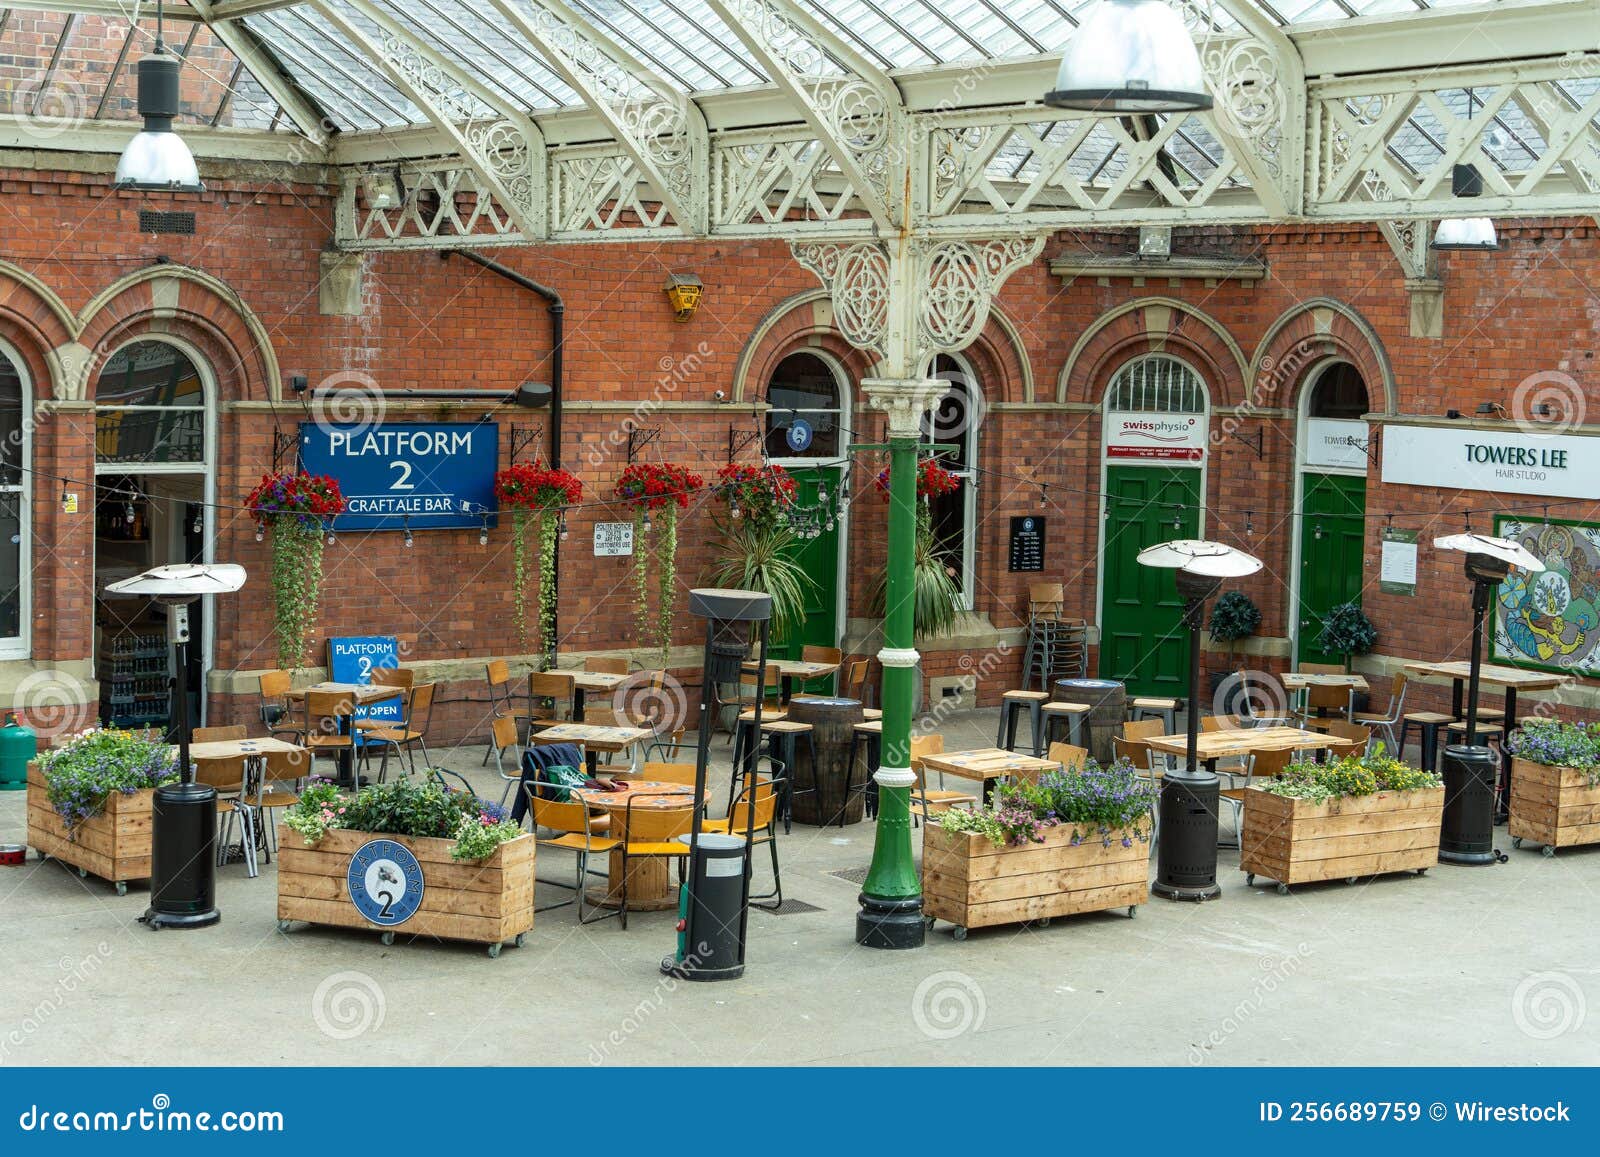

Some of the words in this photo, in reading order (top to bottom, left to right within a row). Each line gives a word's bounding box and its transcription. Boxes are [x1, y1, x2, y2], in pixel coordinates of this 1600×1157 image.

[1123, 420, 1189, 432] swissphysio
[330, 431, 472, 456] PLATFORM
[1465, 444, 1537, 466] TOWERS
[1541, 449, 1568, 468] LEE
[389, 461, 414, 489] 2
[1495, 469, 1514, 479] HAIR
[1516, 471, 1546, 481] STUDIO
[349, 499, 395, 513] CRAFT
[396, 499, 421, 512] ALE
[425, 498, 452, 511] BAR
[336, 643, 393, 655] PLATFORM
[358, 656, 371, 677] 2
[370, 706, 397, 715] OPEN
[352, 843, 420, 894] PLATFORM
[378, 891, 394, 918] 2
